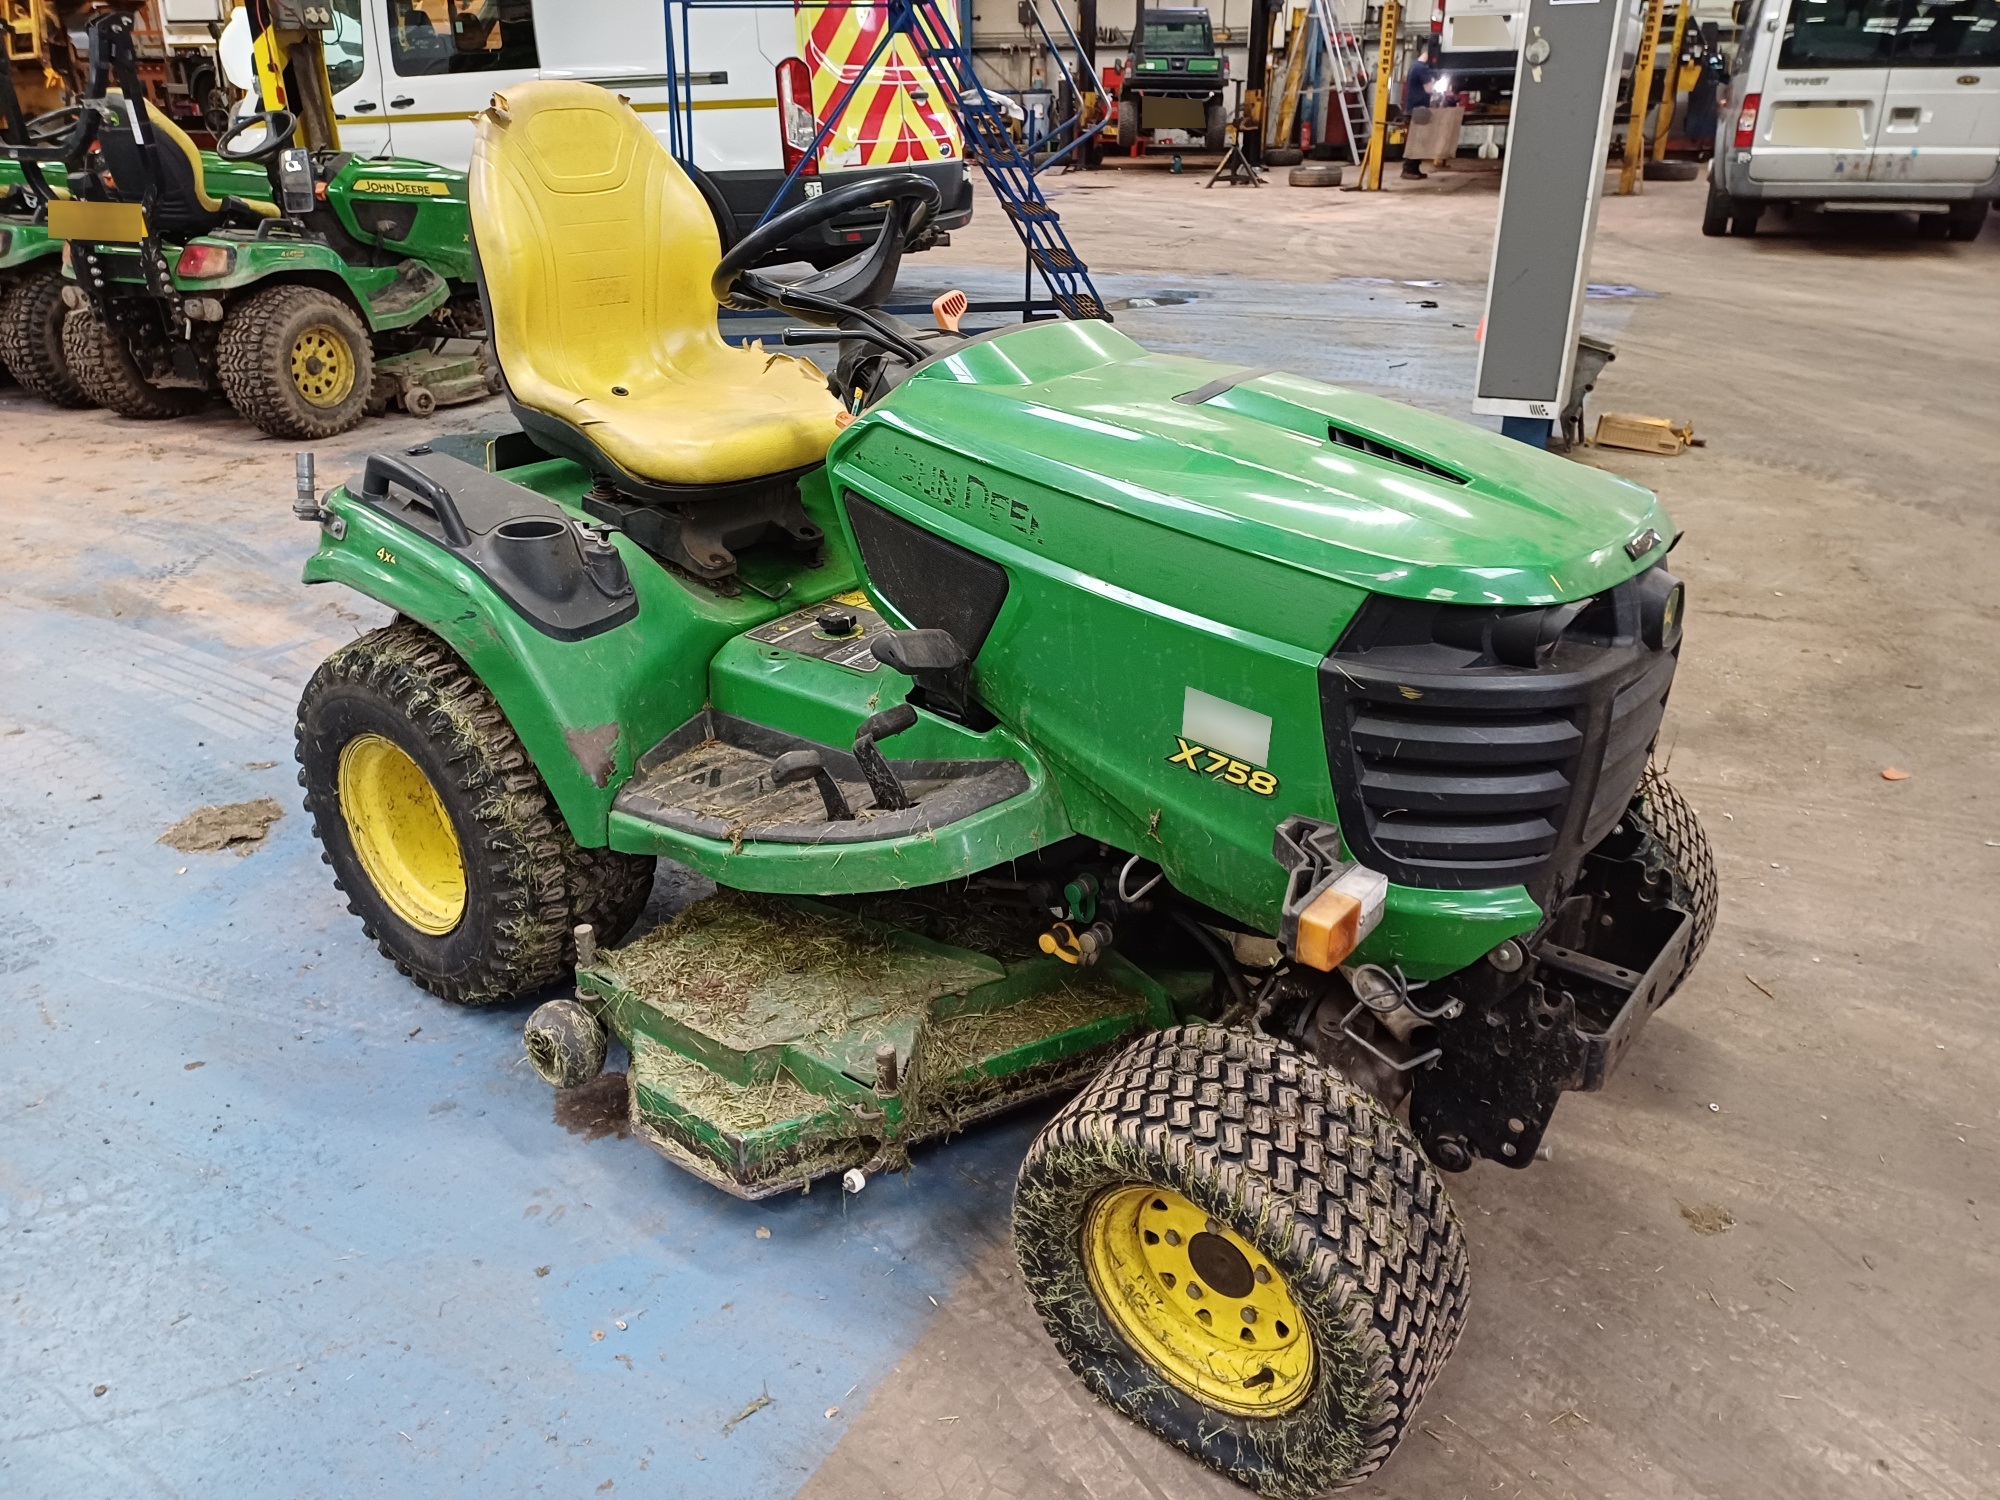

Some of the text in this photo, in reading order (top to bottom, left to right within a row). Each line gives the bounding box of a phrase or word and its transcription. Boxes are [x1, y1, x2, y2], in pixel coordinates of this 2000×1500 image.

[1382, 4, 1395, 75] BRADBURY
[365, 181, 431, 195] JOHN DEERE
[1164, 735, 1279, 796] X758
